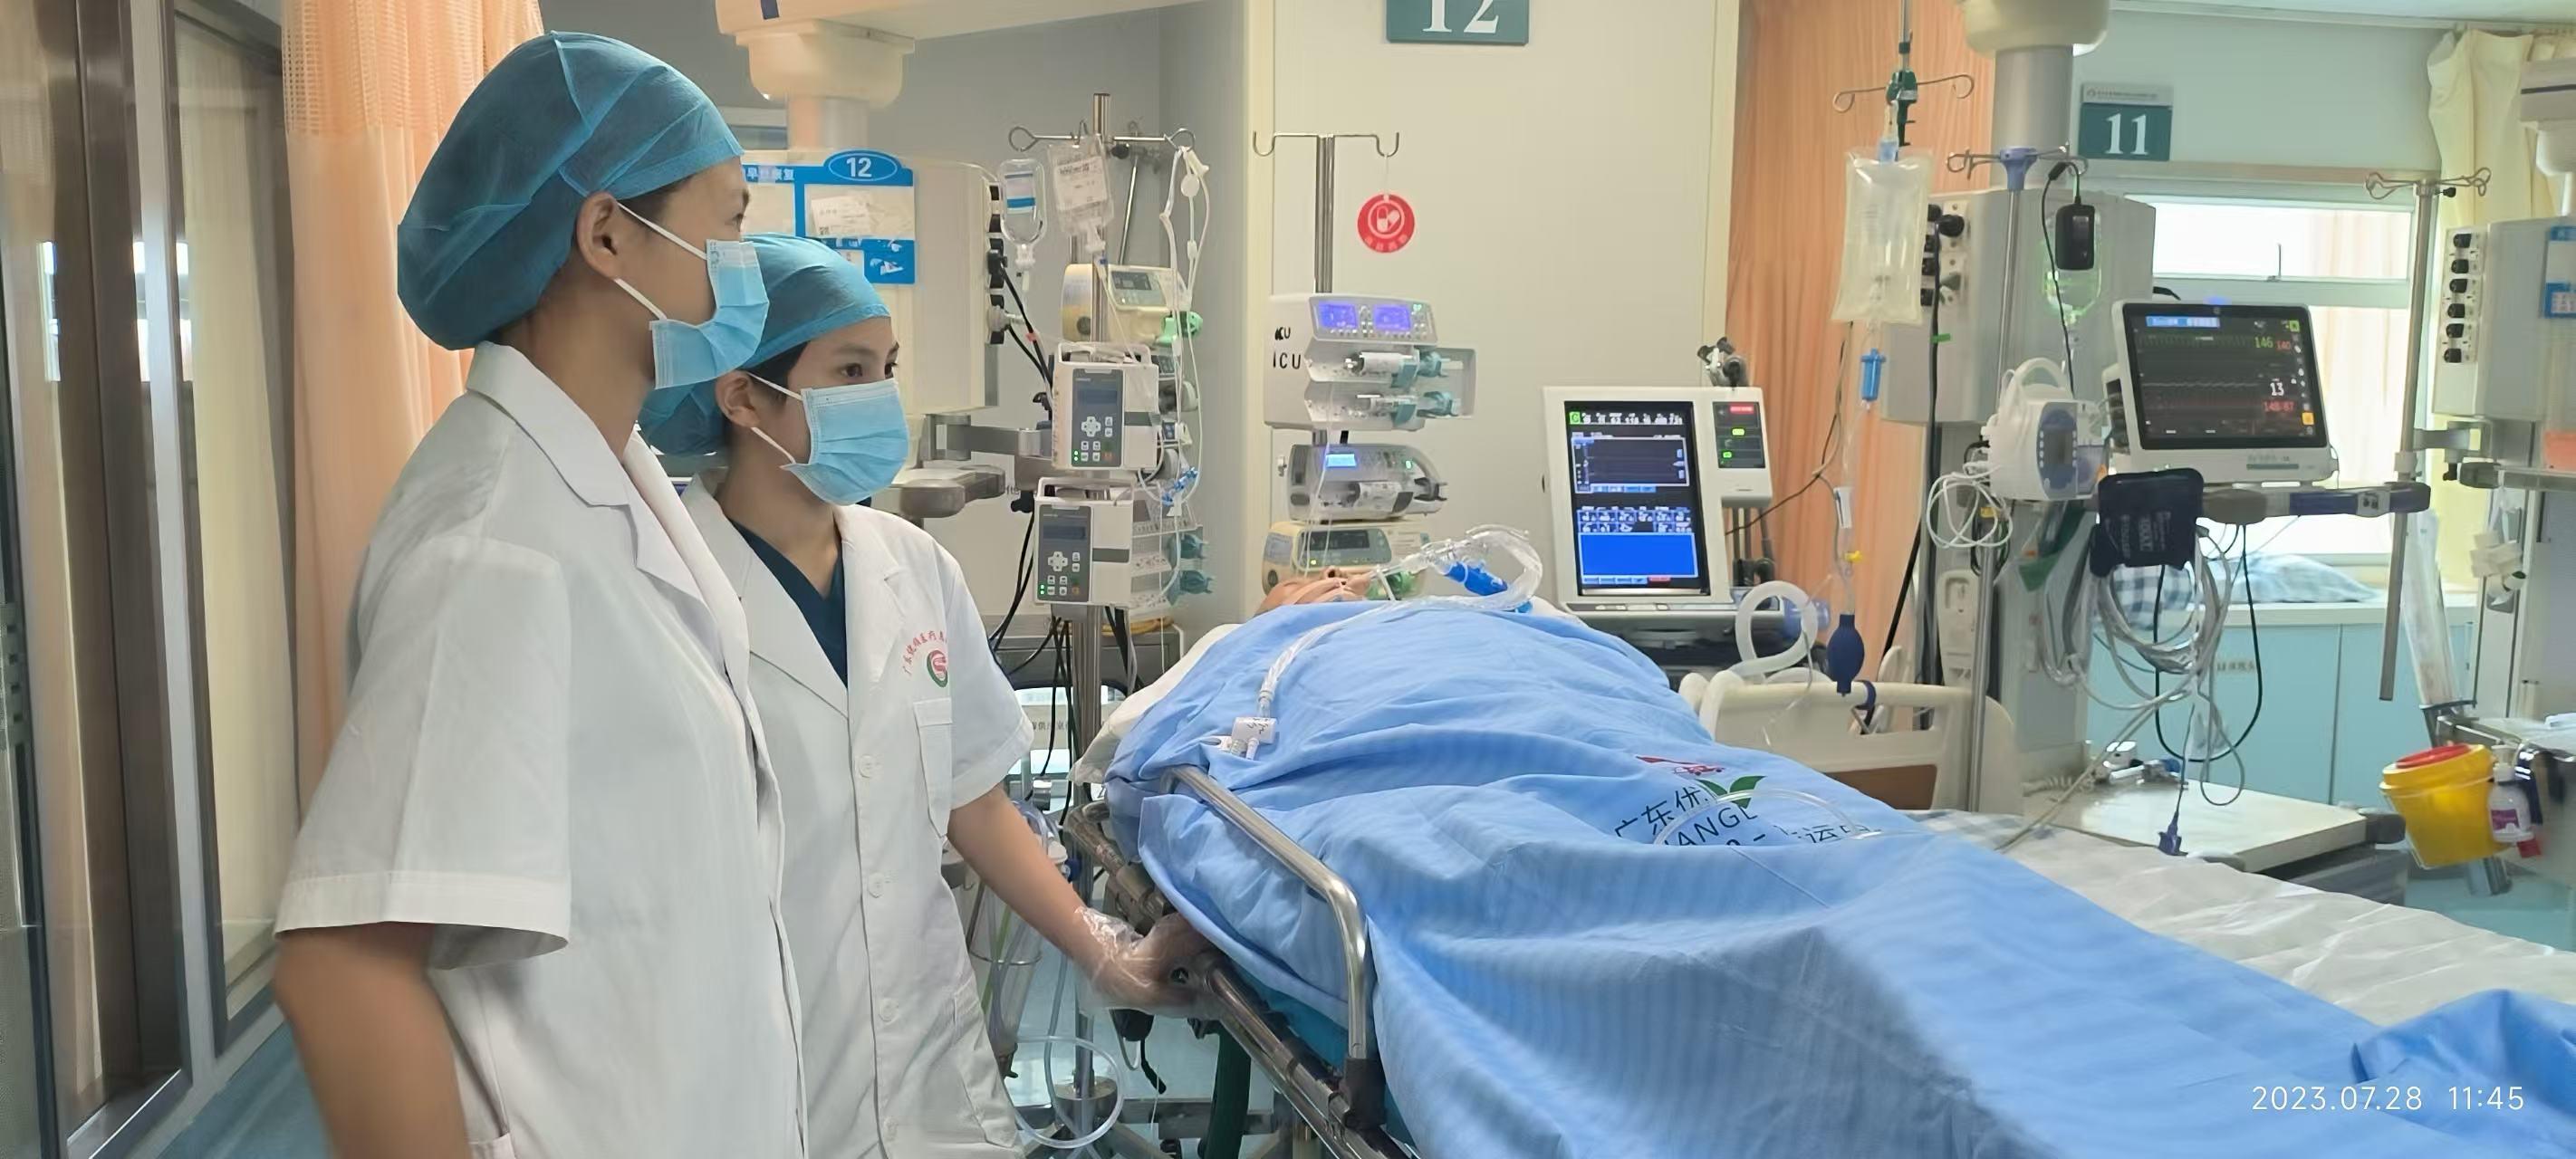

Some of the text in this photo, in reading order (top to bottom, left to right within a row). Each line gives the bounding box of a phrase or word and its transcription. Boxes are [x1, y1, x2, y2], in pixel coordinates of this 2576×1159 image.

[2104, 112, 2149, 156] 11
[846, 158, 872, 177] 12
[2270, 382, 2284, 397] 13
